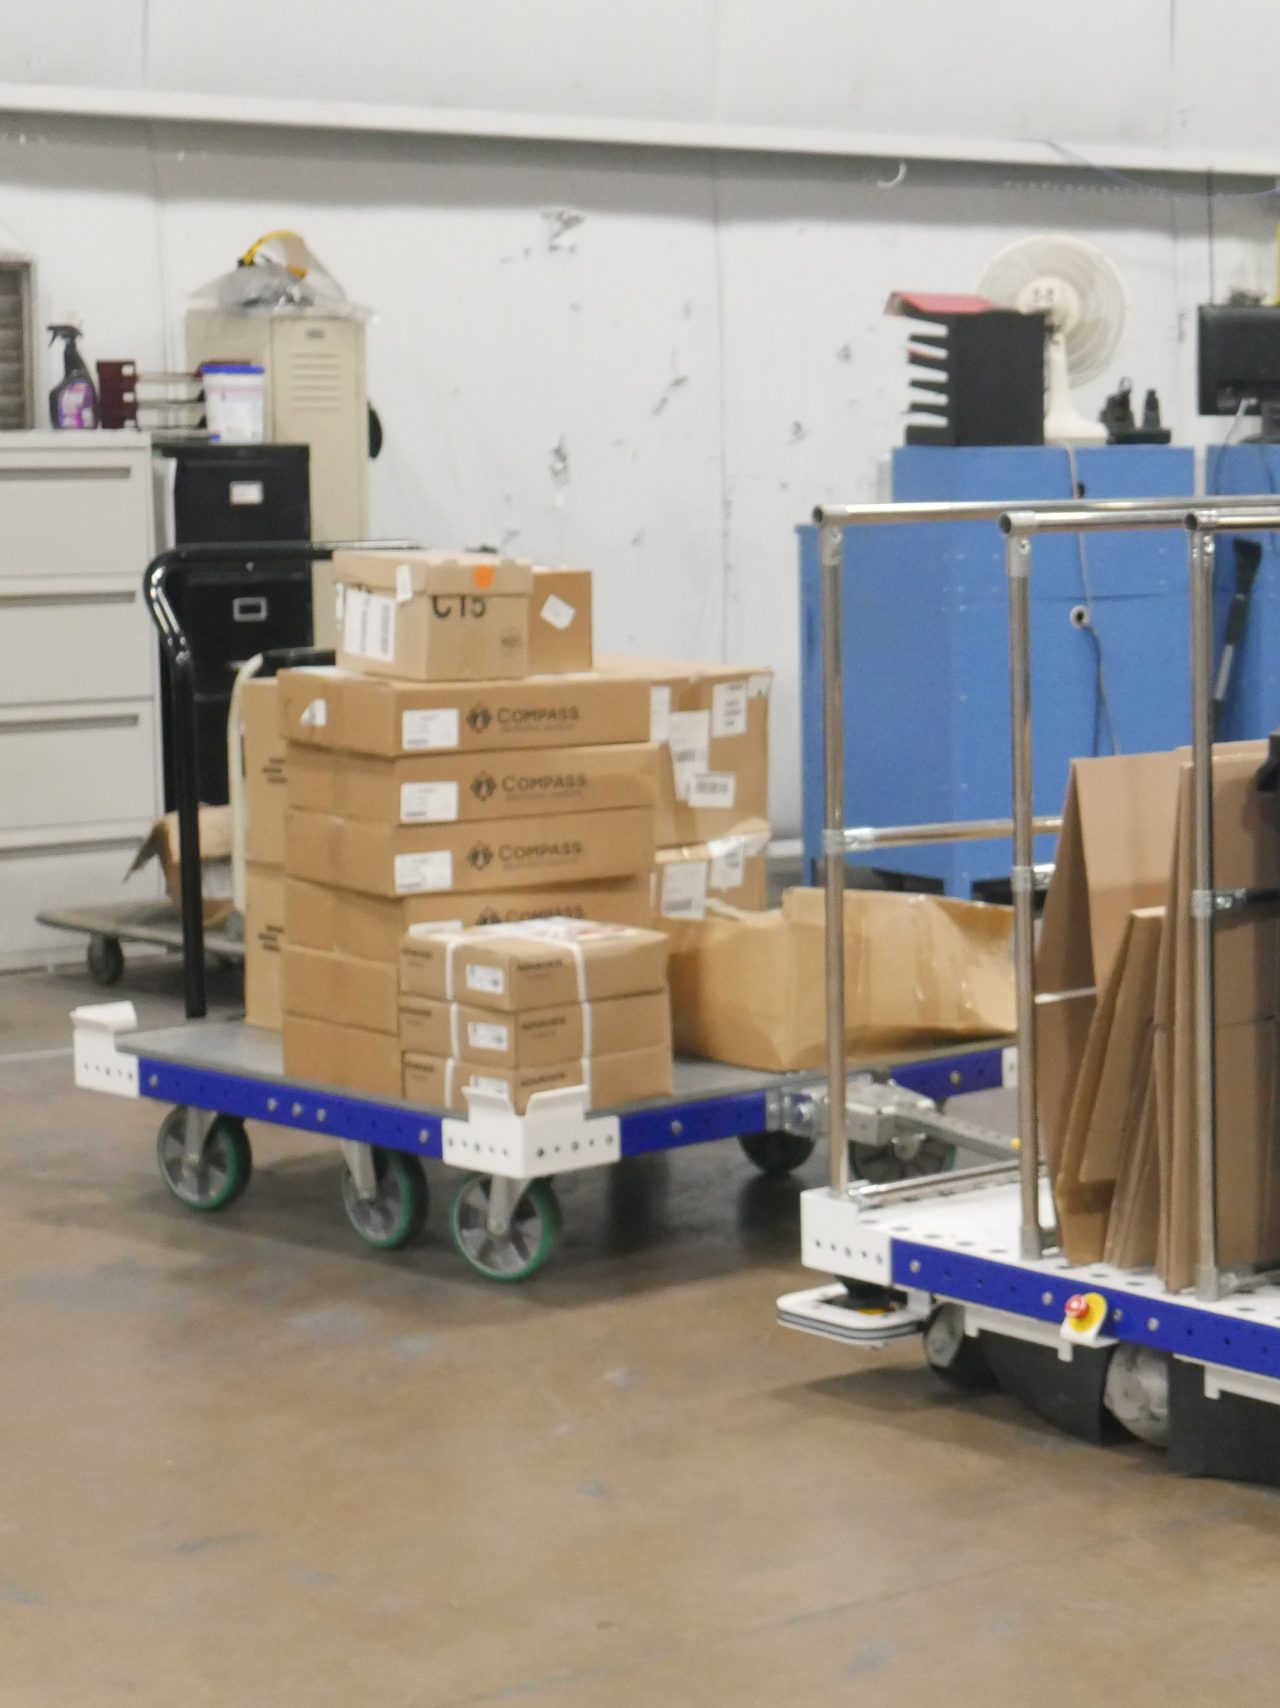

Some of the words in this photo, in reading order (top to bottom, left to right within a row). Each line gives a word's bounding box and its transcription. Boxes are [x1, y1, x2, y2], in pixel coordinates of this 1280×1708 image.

[496, 706, 580, 724] COMPASS
[502, 773, 587, 792] COMPASS
[498, 841, 583, 861] COMPASS
